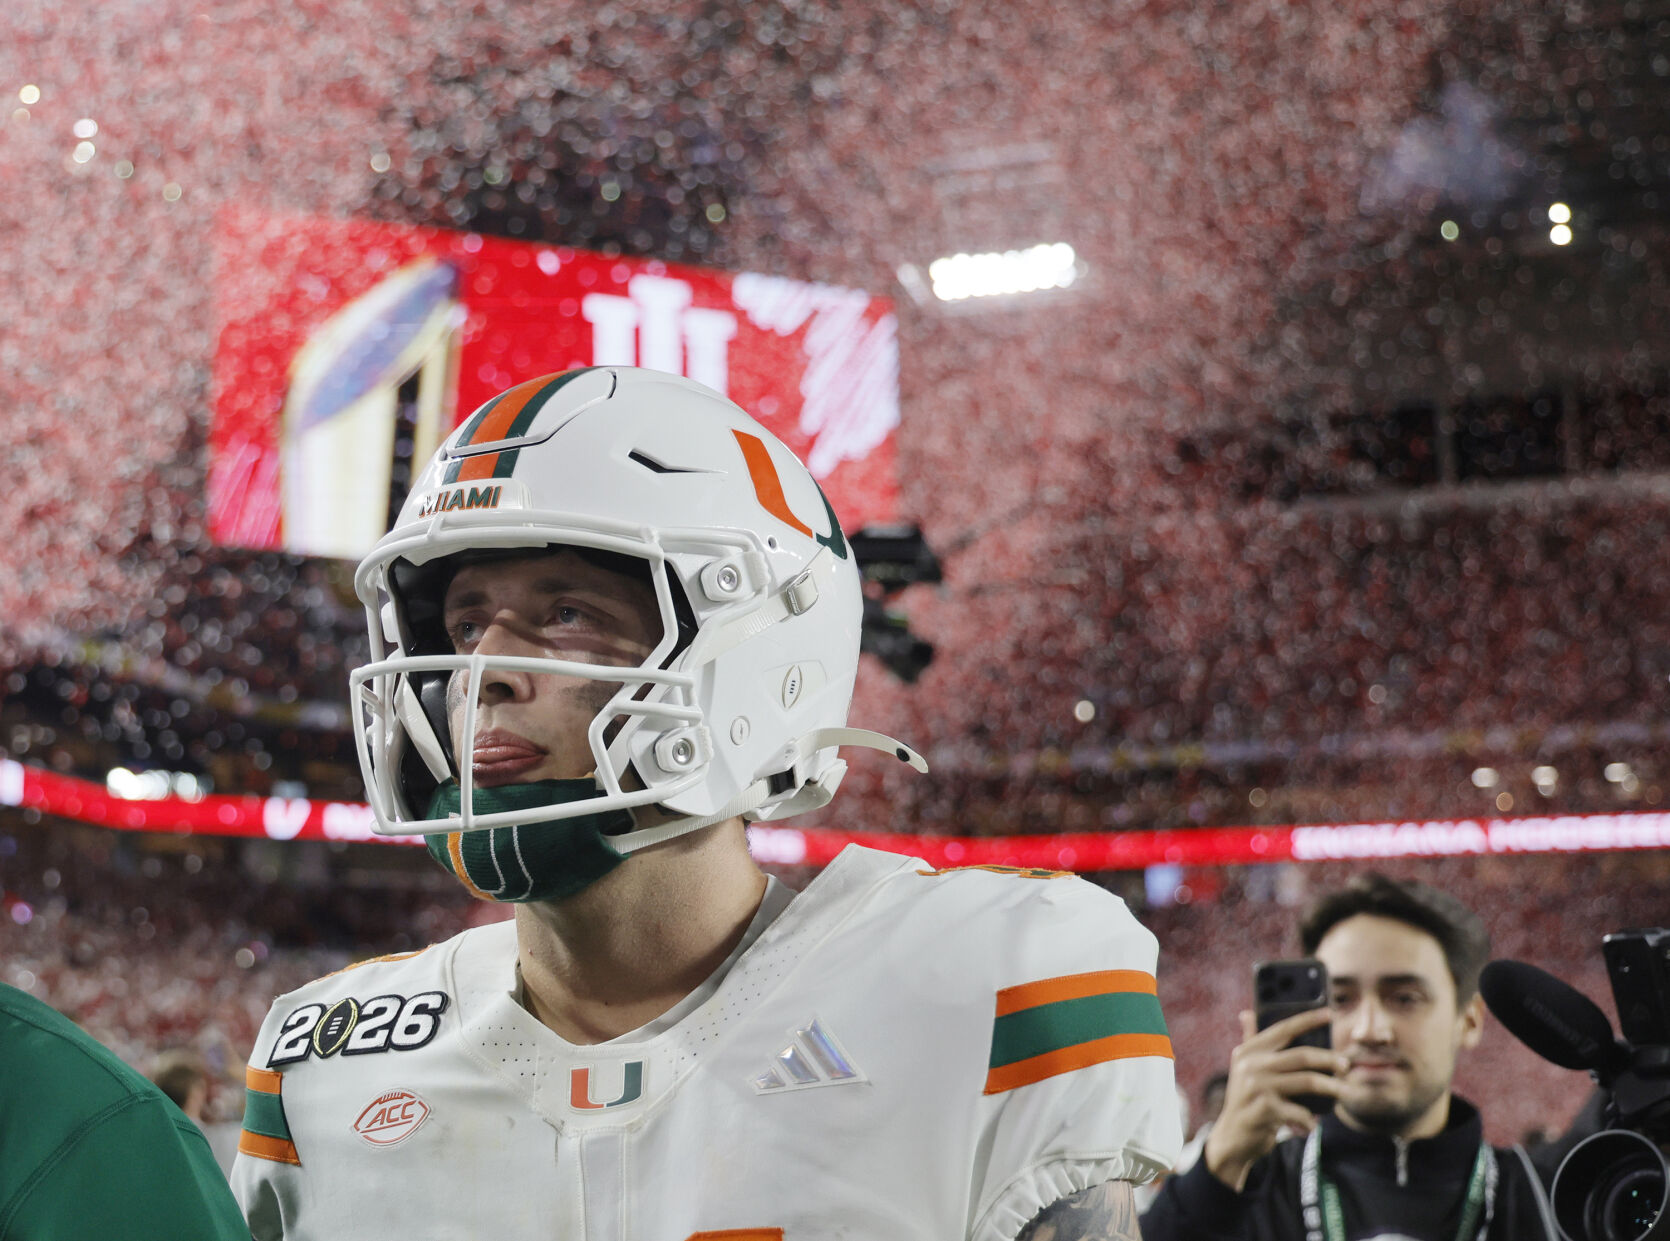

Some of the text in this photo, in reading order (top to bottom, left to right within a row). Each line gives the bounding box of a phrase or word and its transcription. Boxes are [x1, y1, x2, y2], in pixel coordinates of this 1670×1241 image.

[418, 485, 503, 518] MIAMI
[569, 1060, 643, 1109] U
[365, 1100, 416, 1128] ACC
